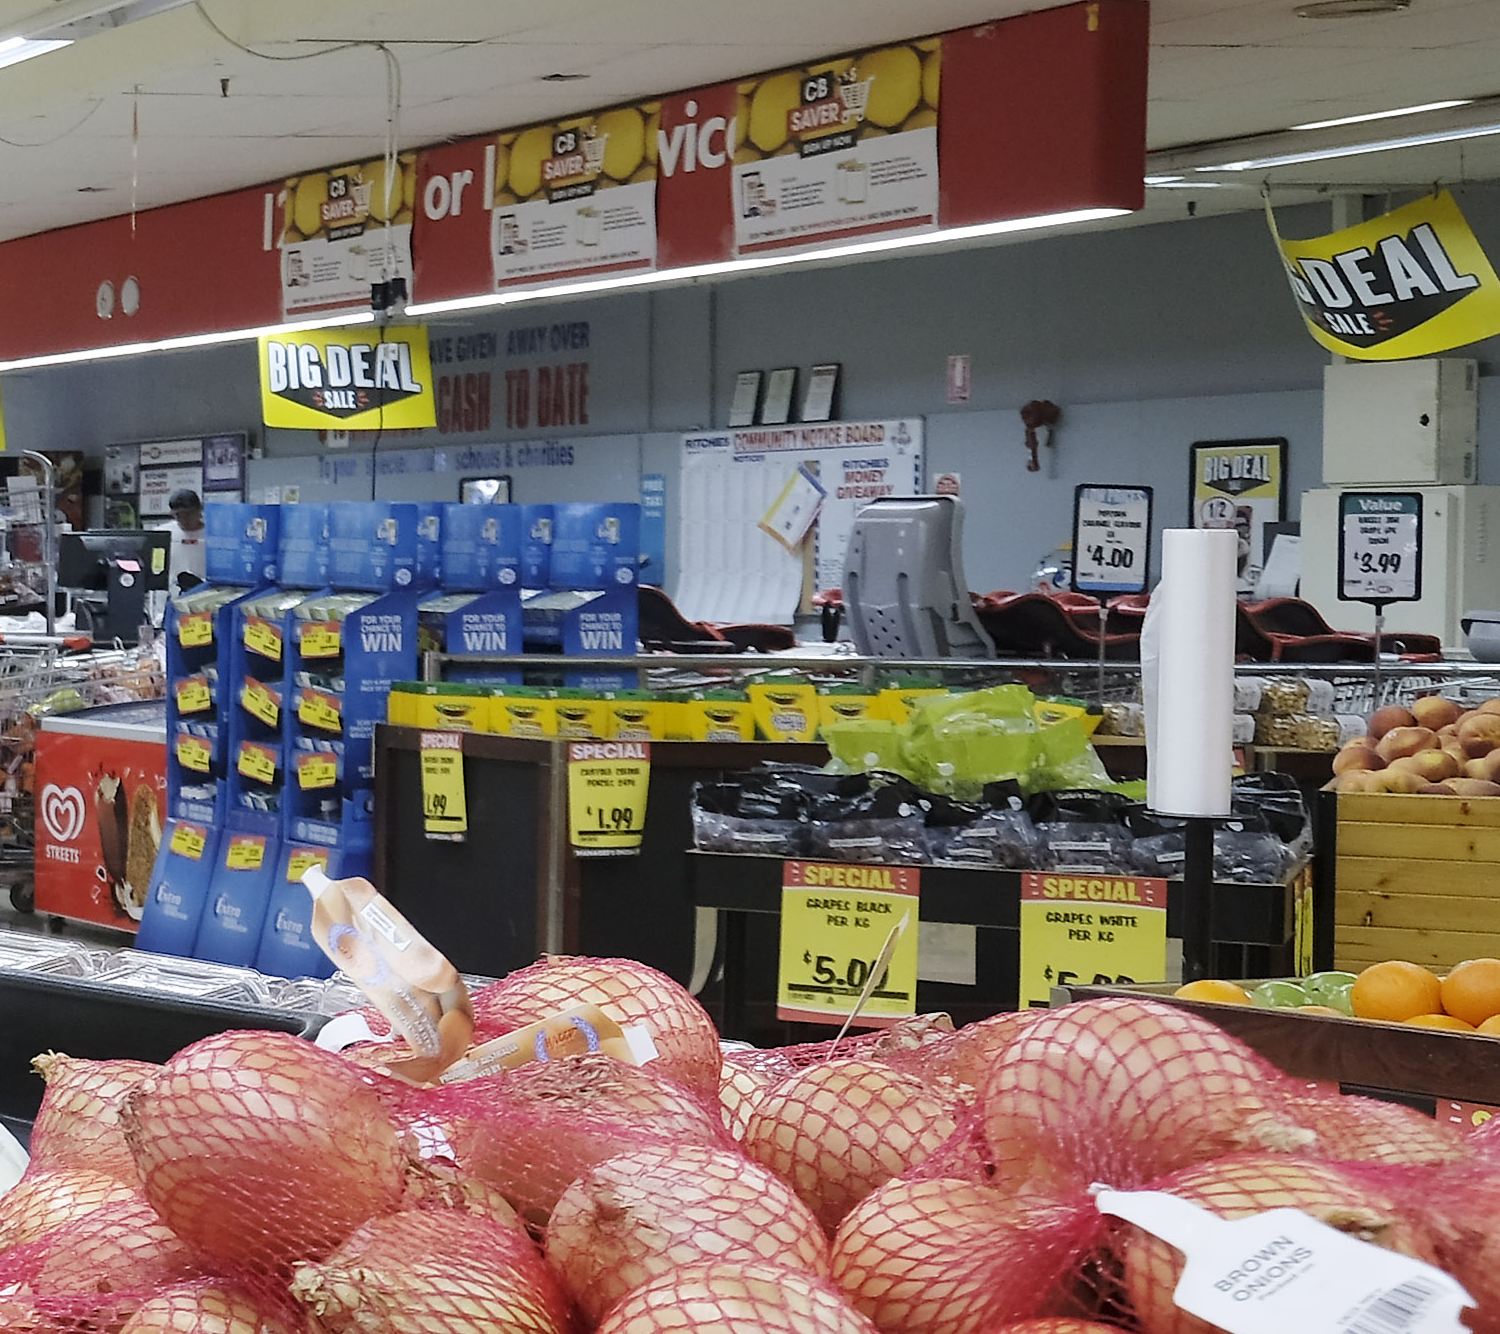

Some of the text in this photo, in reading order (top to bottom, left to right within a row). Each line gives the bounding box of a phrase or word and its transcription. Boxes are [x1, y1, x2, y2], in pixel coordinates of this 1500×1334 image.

[791, 102, 840, 132] SAVER
[543, 155, 584, 180] SAVER
[423, 169, 474, 221] or
[322, 200, 356, 222] SAVER
[1295, 222, 1481, 310] DEAL
[1323, 310, 1376, 337] SALE
[455, 321, 590, 360] GIVEN AWAY OVER
[267, 341, 422, 394] BIG DEAL
[323, 390, 357, 410] SALE
[437, 362, 589, 435] CASH TO DATE
[685, 424, 885, 452] RITCHIES COMMUNITY NOTICE BOARD
[844, 470, 885, 484] MONEY
[1231, 453, 1271, 482] DEAL
[1358, 498, 1403, 512] Value
[361, 633, 402, 652] WIN
[463, 632, 507, 651] WIN
[580, 631, 623, 650] WIN
[420, 732, 461, 750] SPECIAL
[571, 743, 648, 760] SPECIAL
[45, 843, 80, 864] STREETS
[804, 865, 896, 890] SPECIAL
[1042, 877, 1141, 902] SPECIAL
[806, 898, 893, 914] GRAPES BLACK
[827, 914, 871, 928] PER KG
[1046, 912, 1139, 928] GRAPES WHITE
[1068, 928, 1115, 943] PER KG
[1214, 1235, 1296, 1294] BROWN
[1231, 1245, 1315, 1303] ONIONS
